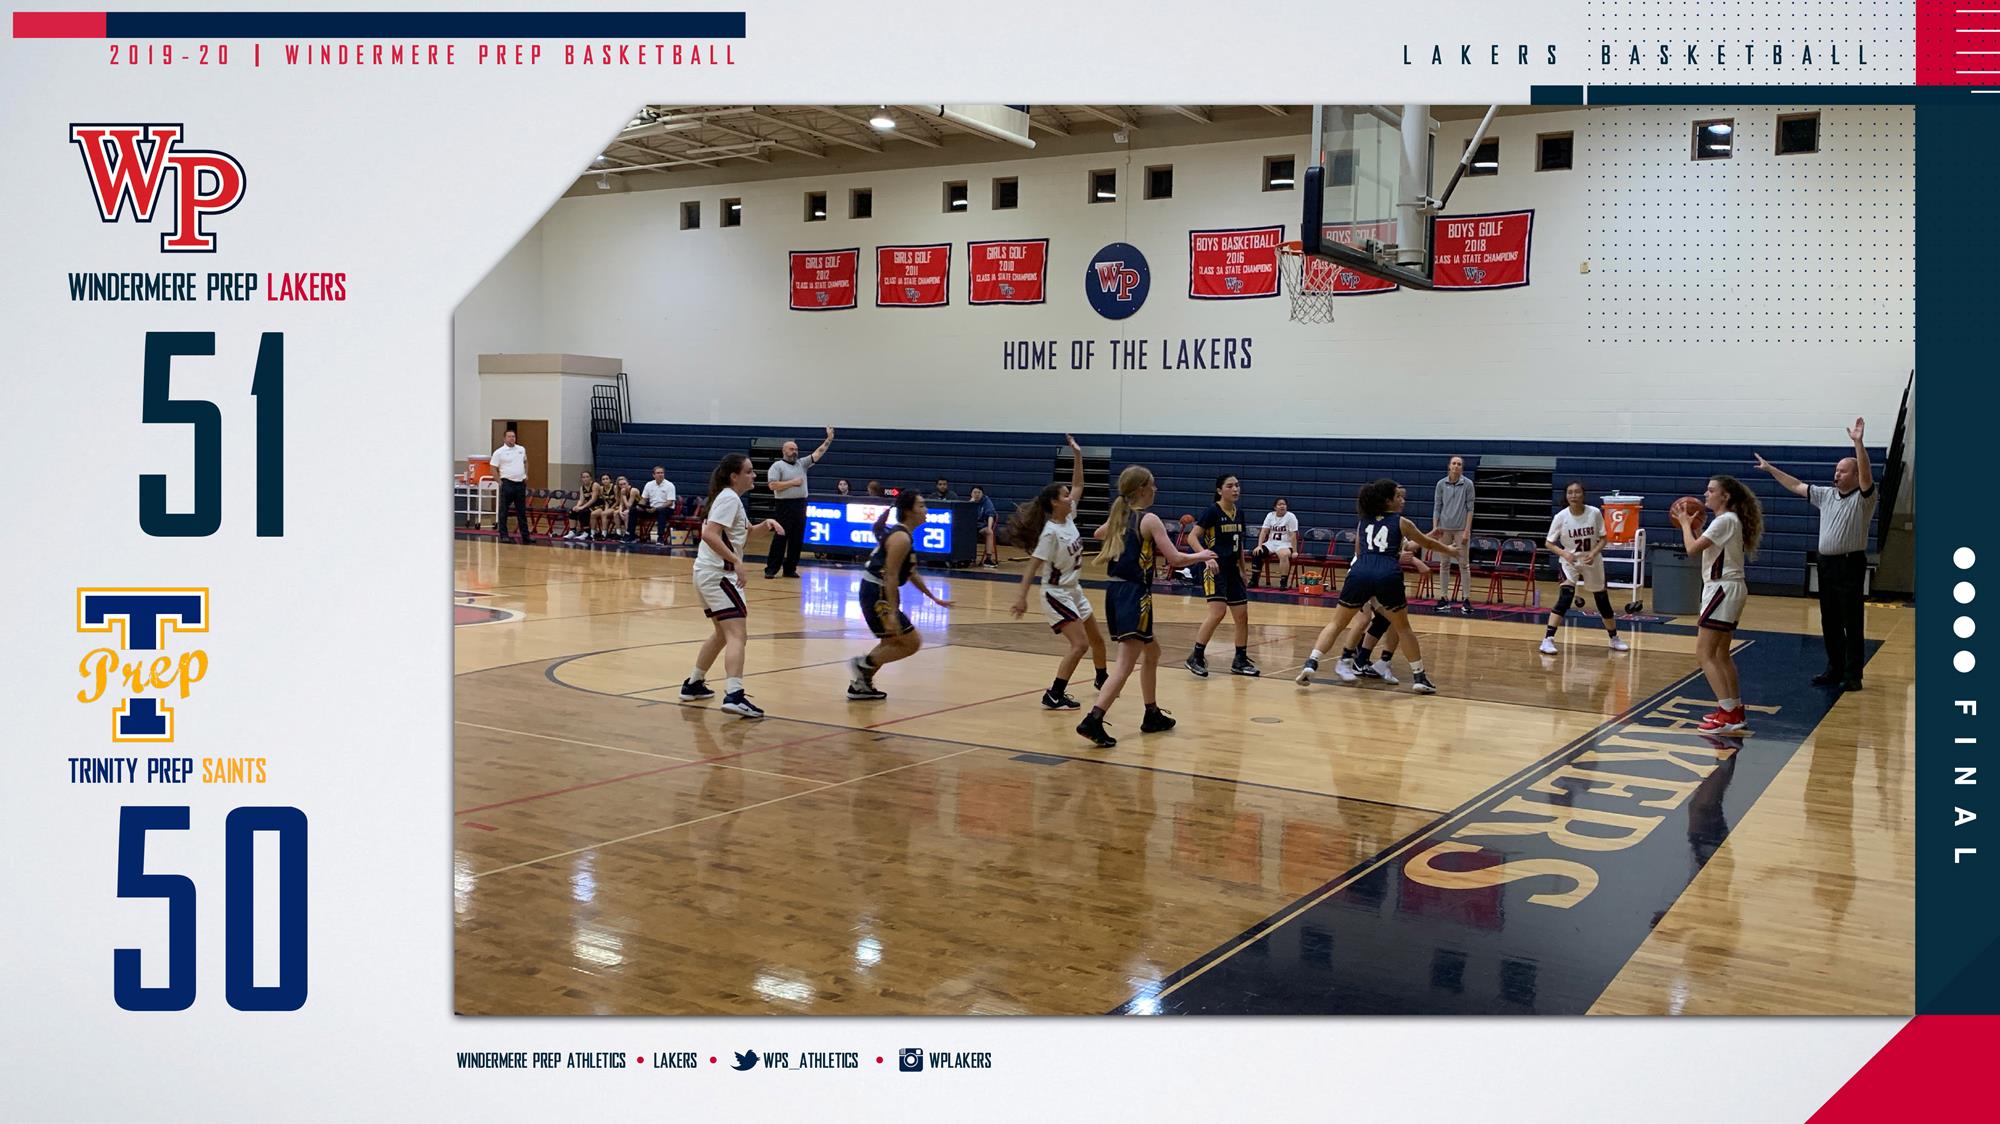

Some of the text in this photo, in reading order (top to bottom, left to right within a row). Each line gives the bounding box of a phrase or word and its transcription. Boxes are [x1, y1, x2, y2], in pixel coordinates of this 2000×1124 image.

[1448, 220, 1504, 239] BOYS GOLF
[1196, 233, 1275, 252] BOYS BASKETBALL
[1464, 239, 1487, 252] 2018
[893, 250, 932, 264] GIRLS GOLF
[986, 246, 1027, 260] GIRLS GOLF
[1226, 251, 1245, 264] 2016
[1462, 254, 1481, 264] STATE
[1483, 251, 1519, 263] CHAMPIONS
[805, 255, 841, 269] GIRLS GOLF
[1225, 265, 1242, 275] STATE
[1242, 263, 1273, 274] CHAMPIONS
[1095, 261, 1140, 301] WP
[1003, 338, 1252, 370] HOME OF THE LAKERS
[806, 505, 841, 519] Home
[1612, 511, 1624, 522] G
[810, 521, 830, 542] 34
[923, 527, 945, 549] 29
[1365, 524, 1389, 553] 14
[1568, 527, 1595, 539] LAKERS
[1574, 538, 1592, 553] 20
[1403, 695, 1782, 909] LAKERS
